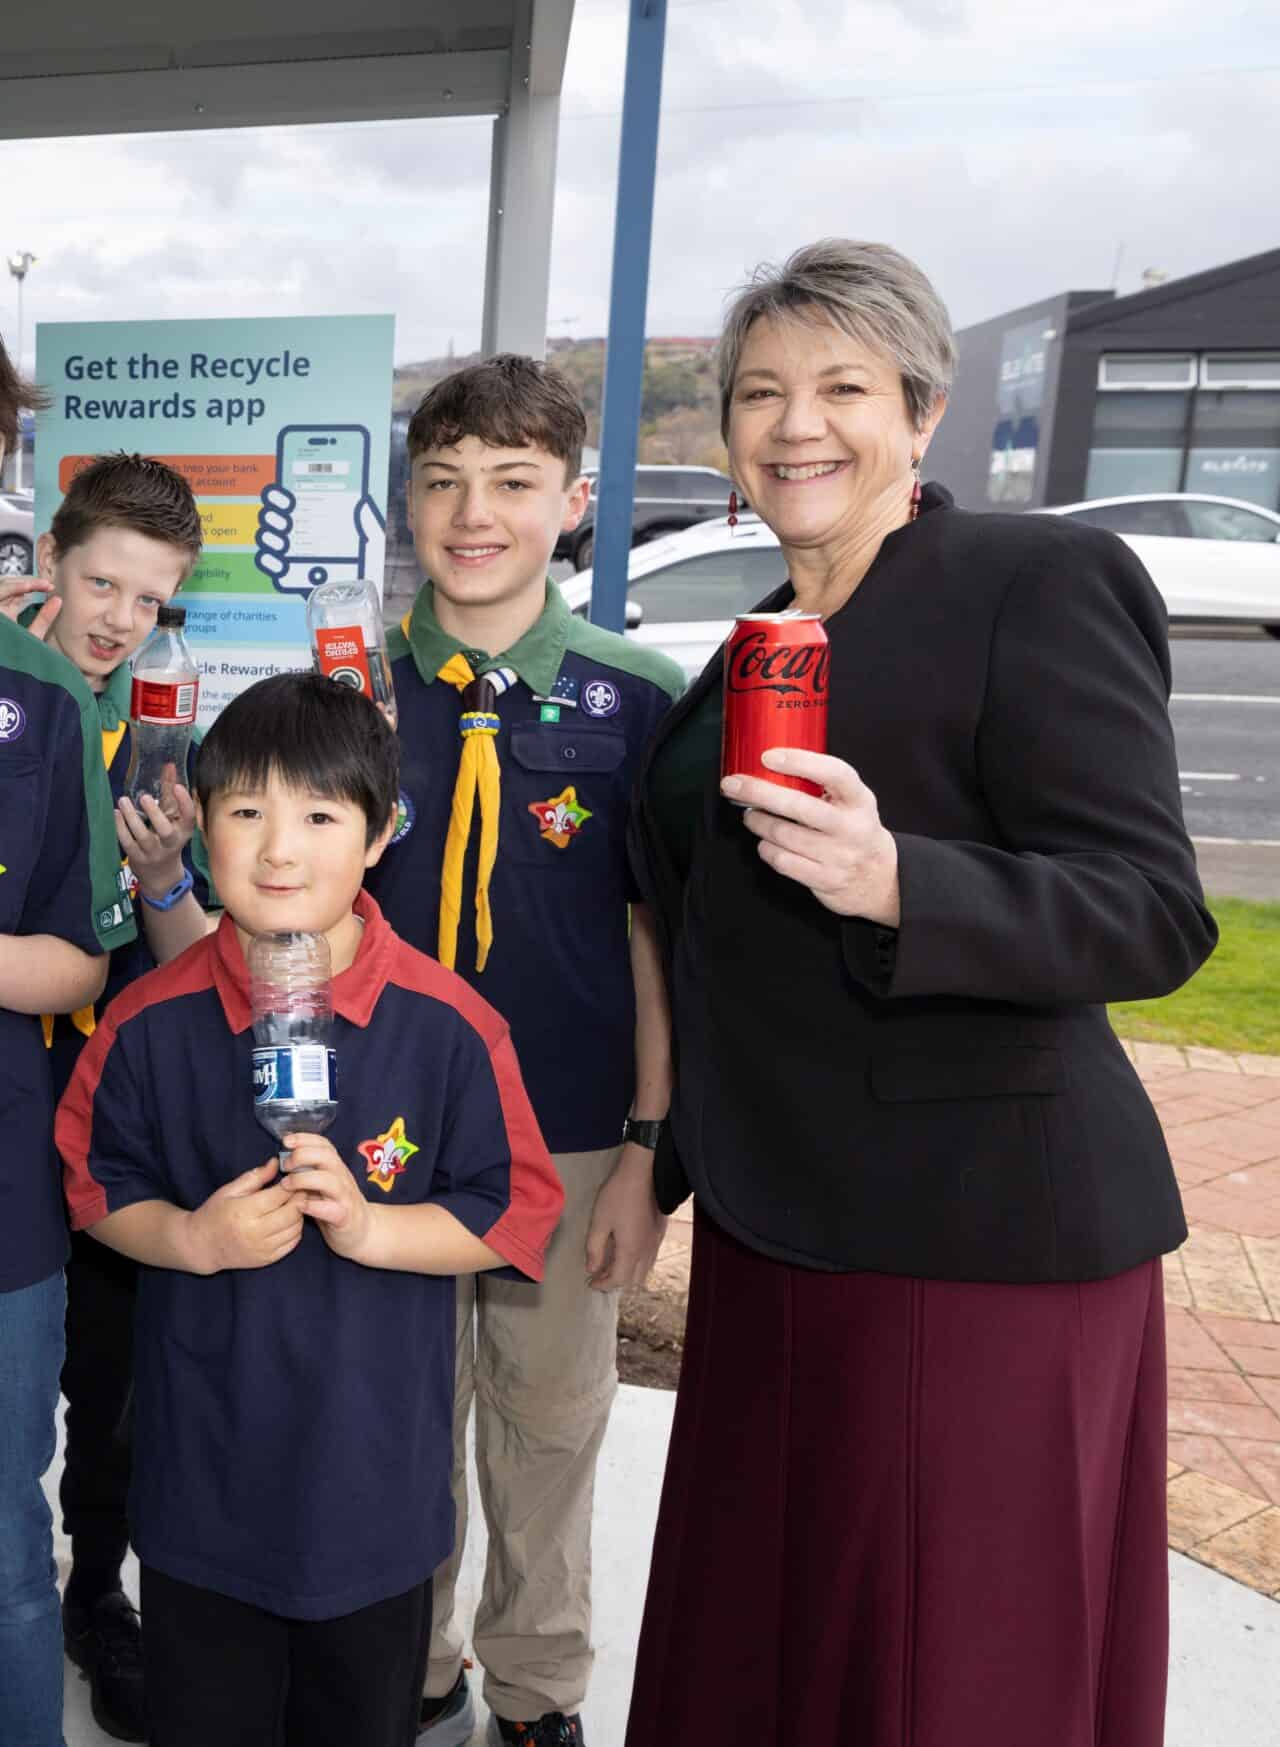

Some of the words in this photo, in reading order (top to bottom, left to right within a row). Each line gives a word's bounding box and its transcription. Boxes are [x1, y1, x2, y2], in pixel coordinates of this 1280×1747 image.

[65, 355, 118, 380] Get
[127, 353, 180, 380] the
[190, 350, 311, 385] Recycle
[65, 392, 196, 419] Rewards
[206, 396, 266, 426] app
[206, 465, 231, 476] your
[232, 463, 259, 474] bank
[196, 478, 237, 488] account
[210, 527, 238, 540] open
[188, 610, 218, 622] range
[220, 608, 233, 621] of
[233, 609, 278, 622] charities
[221, 662, 281, 677] Rewards
[202, 687, 219, 699] the
[776, 700, 812, 709] ZERO
